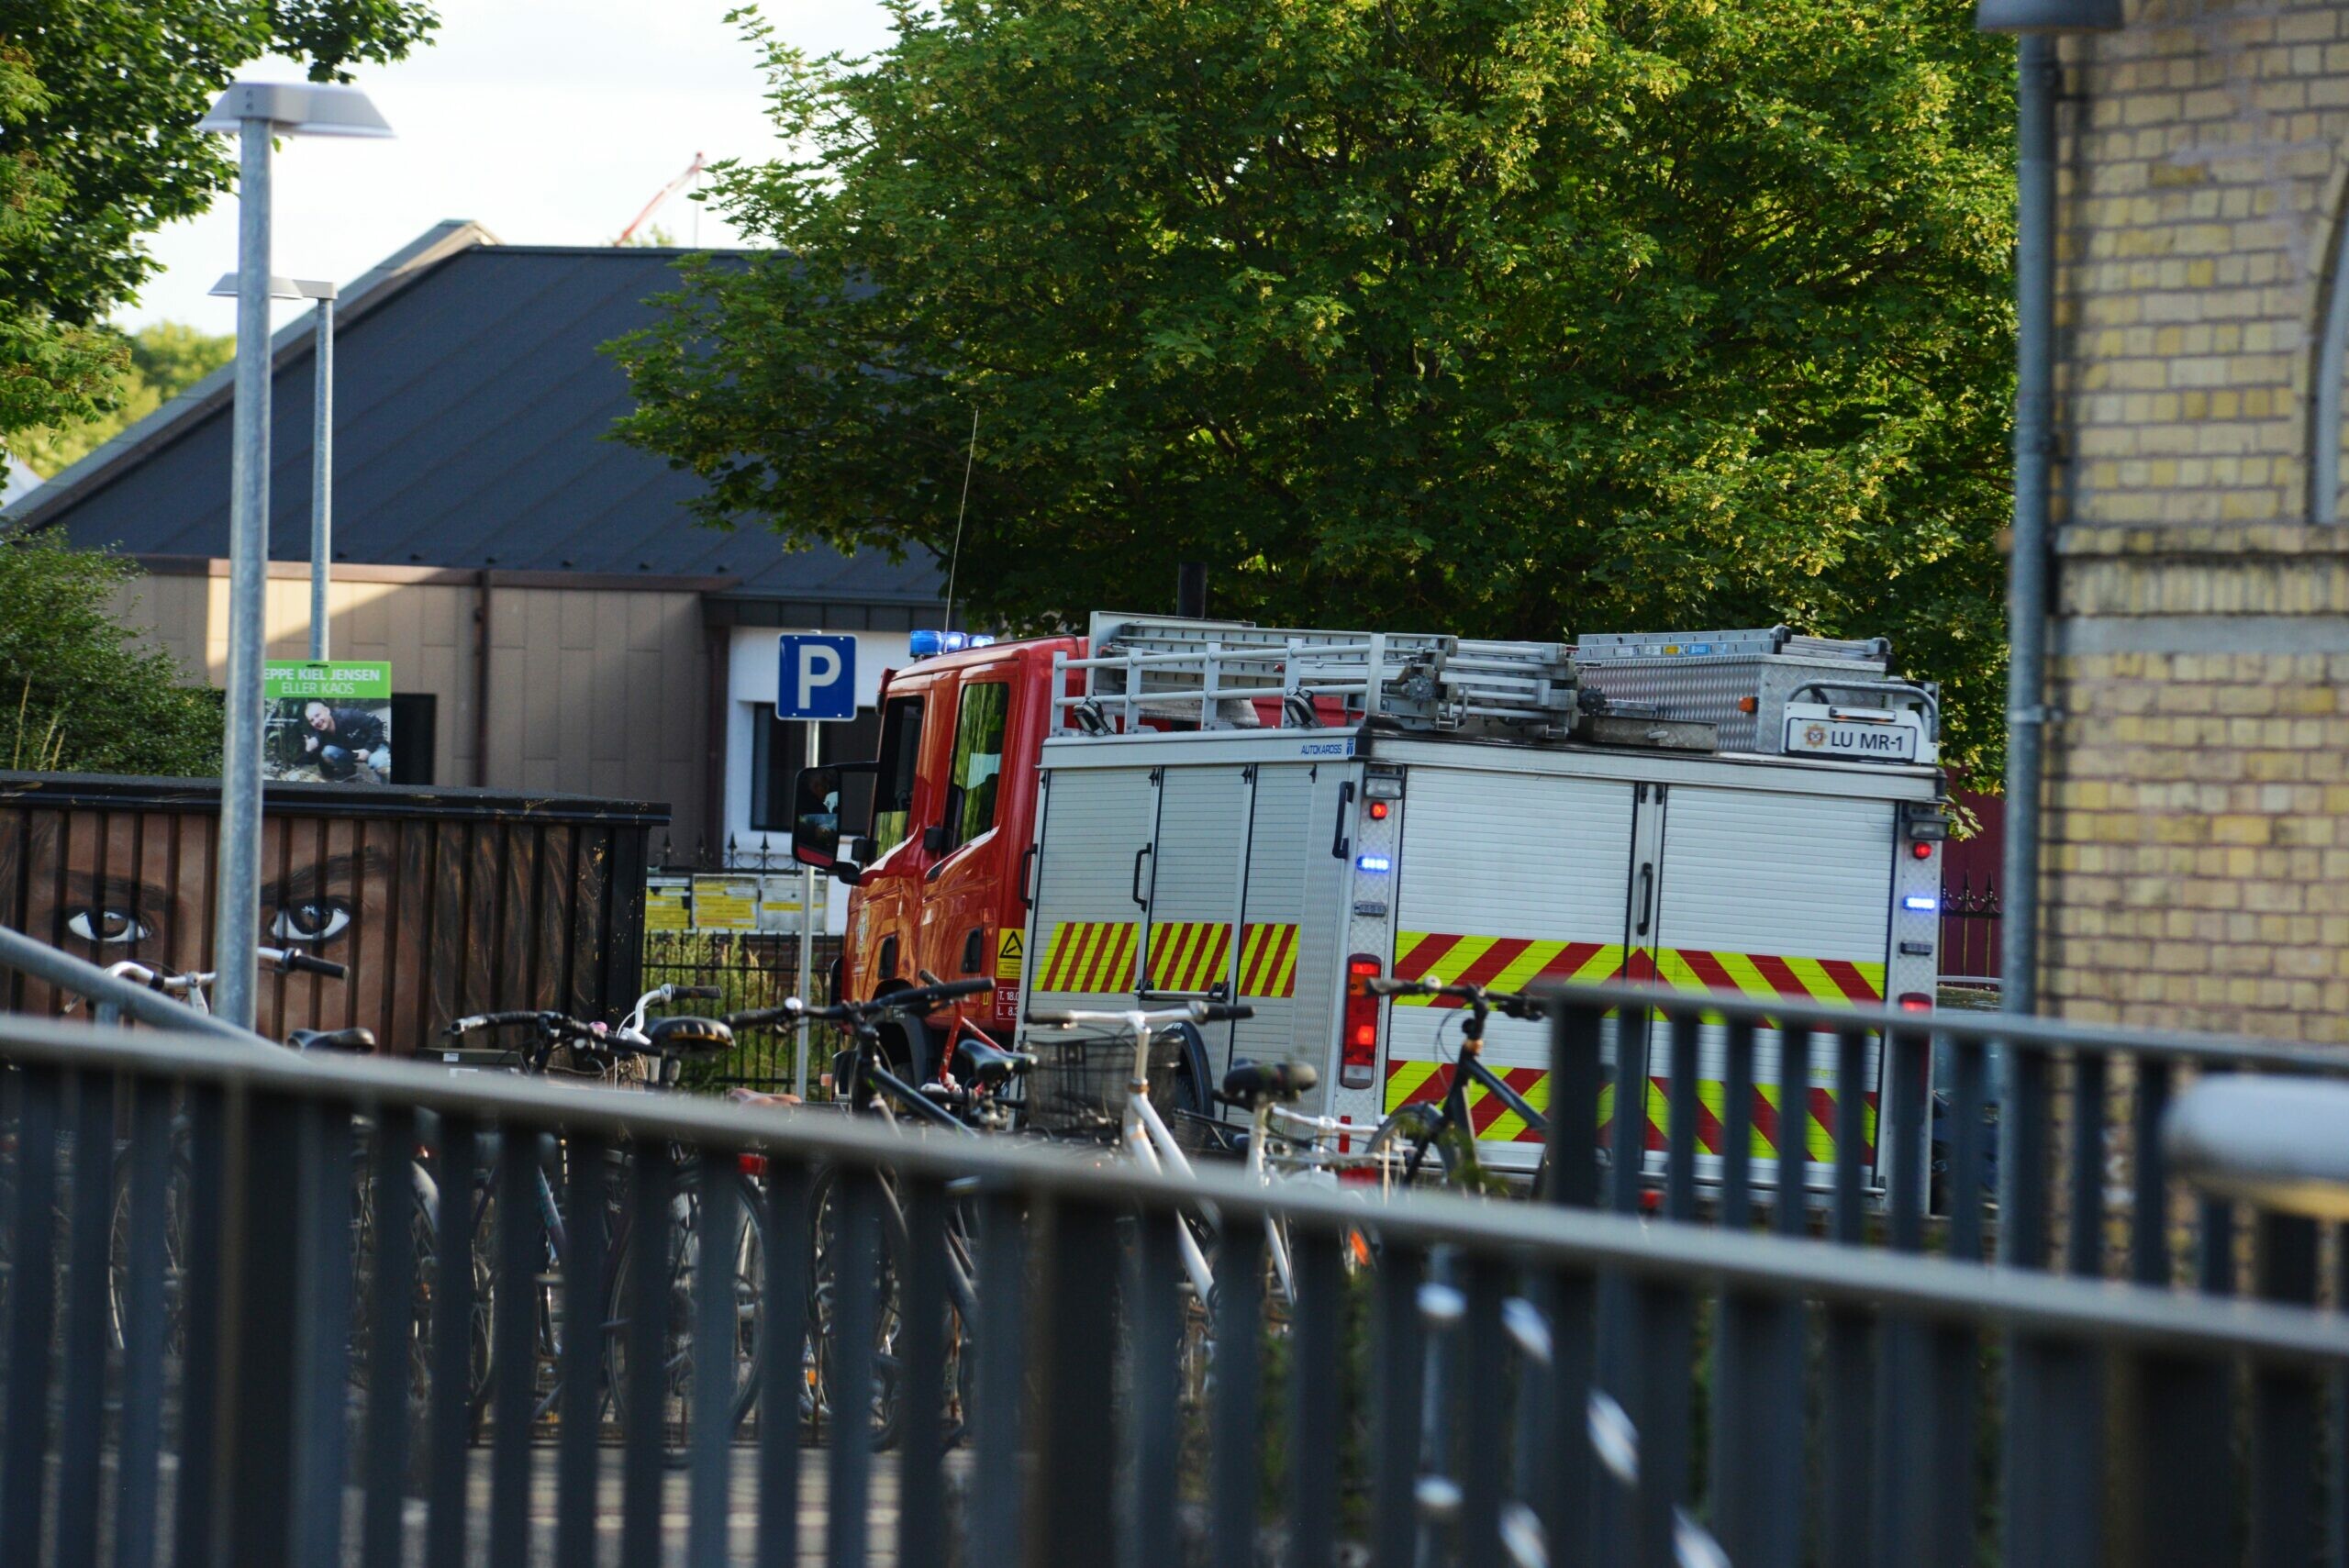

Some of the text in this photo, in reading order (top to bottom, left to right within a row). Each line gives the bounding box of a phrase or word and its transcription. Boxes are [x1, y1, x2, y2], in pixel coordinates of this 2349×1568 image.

[263, 668, 381, 682] EPPE KIEL JENSEN
[798, 644, 841, 709] P
[282, 683, 355, 695] ELLER KAOS
[1831, 730, 1904, 752] LU MR-1
[1301, 743, 1342, 755] AUTOKAROSS
